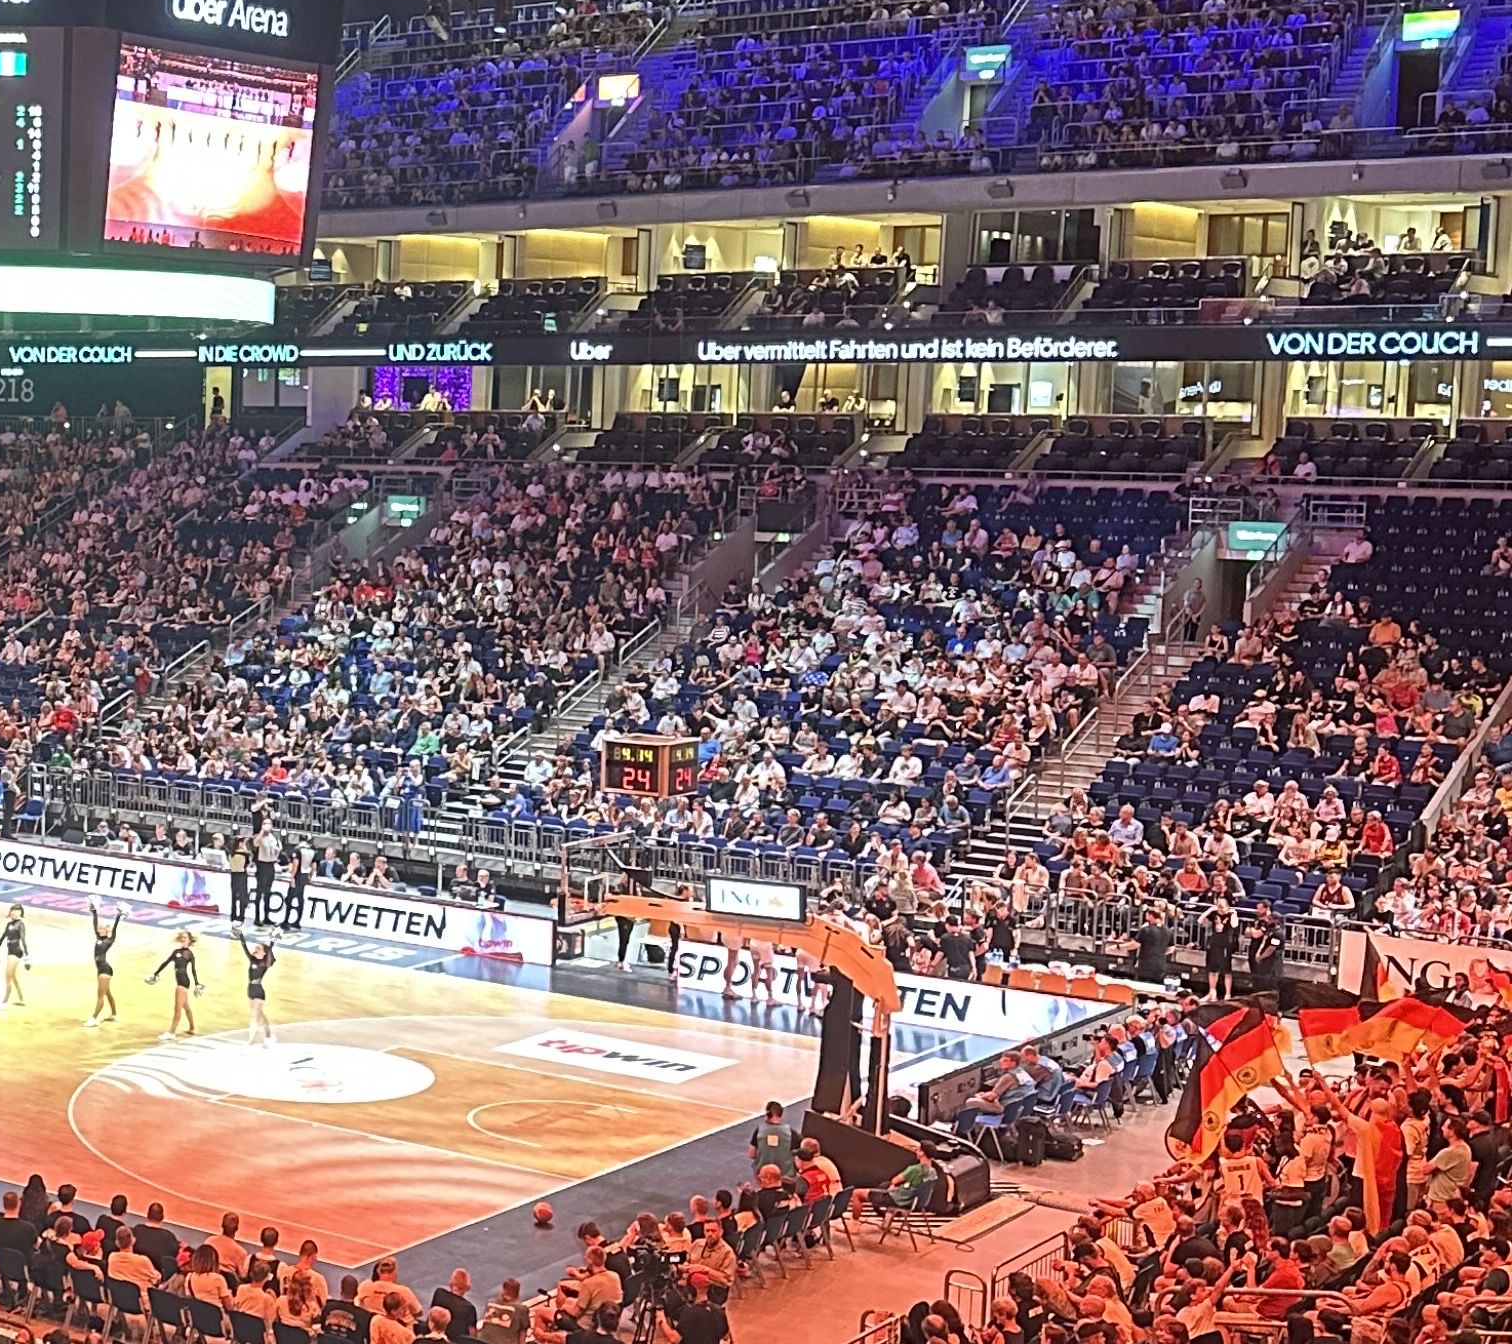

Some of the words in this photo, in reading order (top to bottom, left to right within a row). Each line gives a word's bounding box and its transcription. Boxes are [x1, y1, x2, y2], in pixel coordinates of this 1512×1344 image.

[8, 346, 46, 364] VON
[46, 346, 78, 364] DER
[78, 346, 133, 363] COUCH
[198, 346, 219, 363] IN
[218, 345, 239, 362] DIE
[238, 345, 299, 363] CROWD
[388, 343, 424, 362] UND
[426, 340, 493, 362] ZURÜCK
[570, 340, 613, 360] Uber
[698, 341, 743, 361] Uber
[829, 339, 899, 360] Fahrten
[901, 338, 940, 359] und
[941, 338, 964, 359] ist
[964, 337, 1004, 359] kein
[1006, 336, 1119, 358] Beförderer.
[1266, 332, 1324, 356] VON
[1327, 332, 1378, 355] DER
[1379, 331, 1479, 355] COUCH
[622, 767, 651, 791] 24
[675, 768, 693, 791] 24
[1384, 954, 1456, 993] NG
[537, 1039, 698, 1072] tipwin
